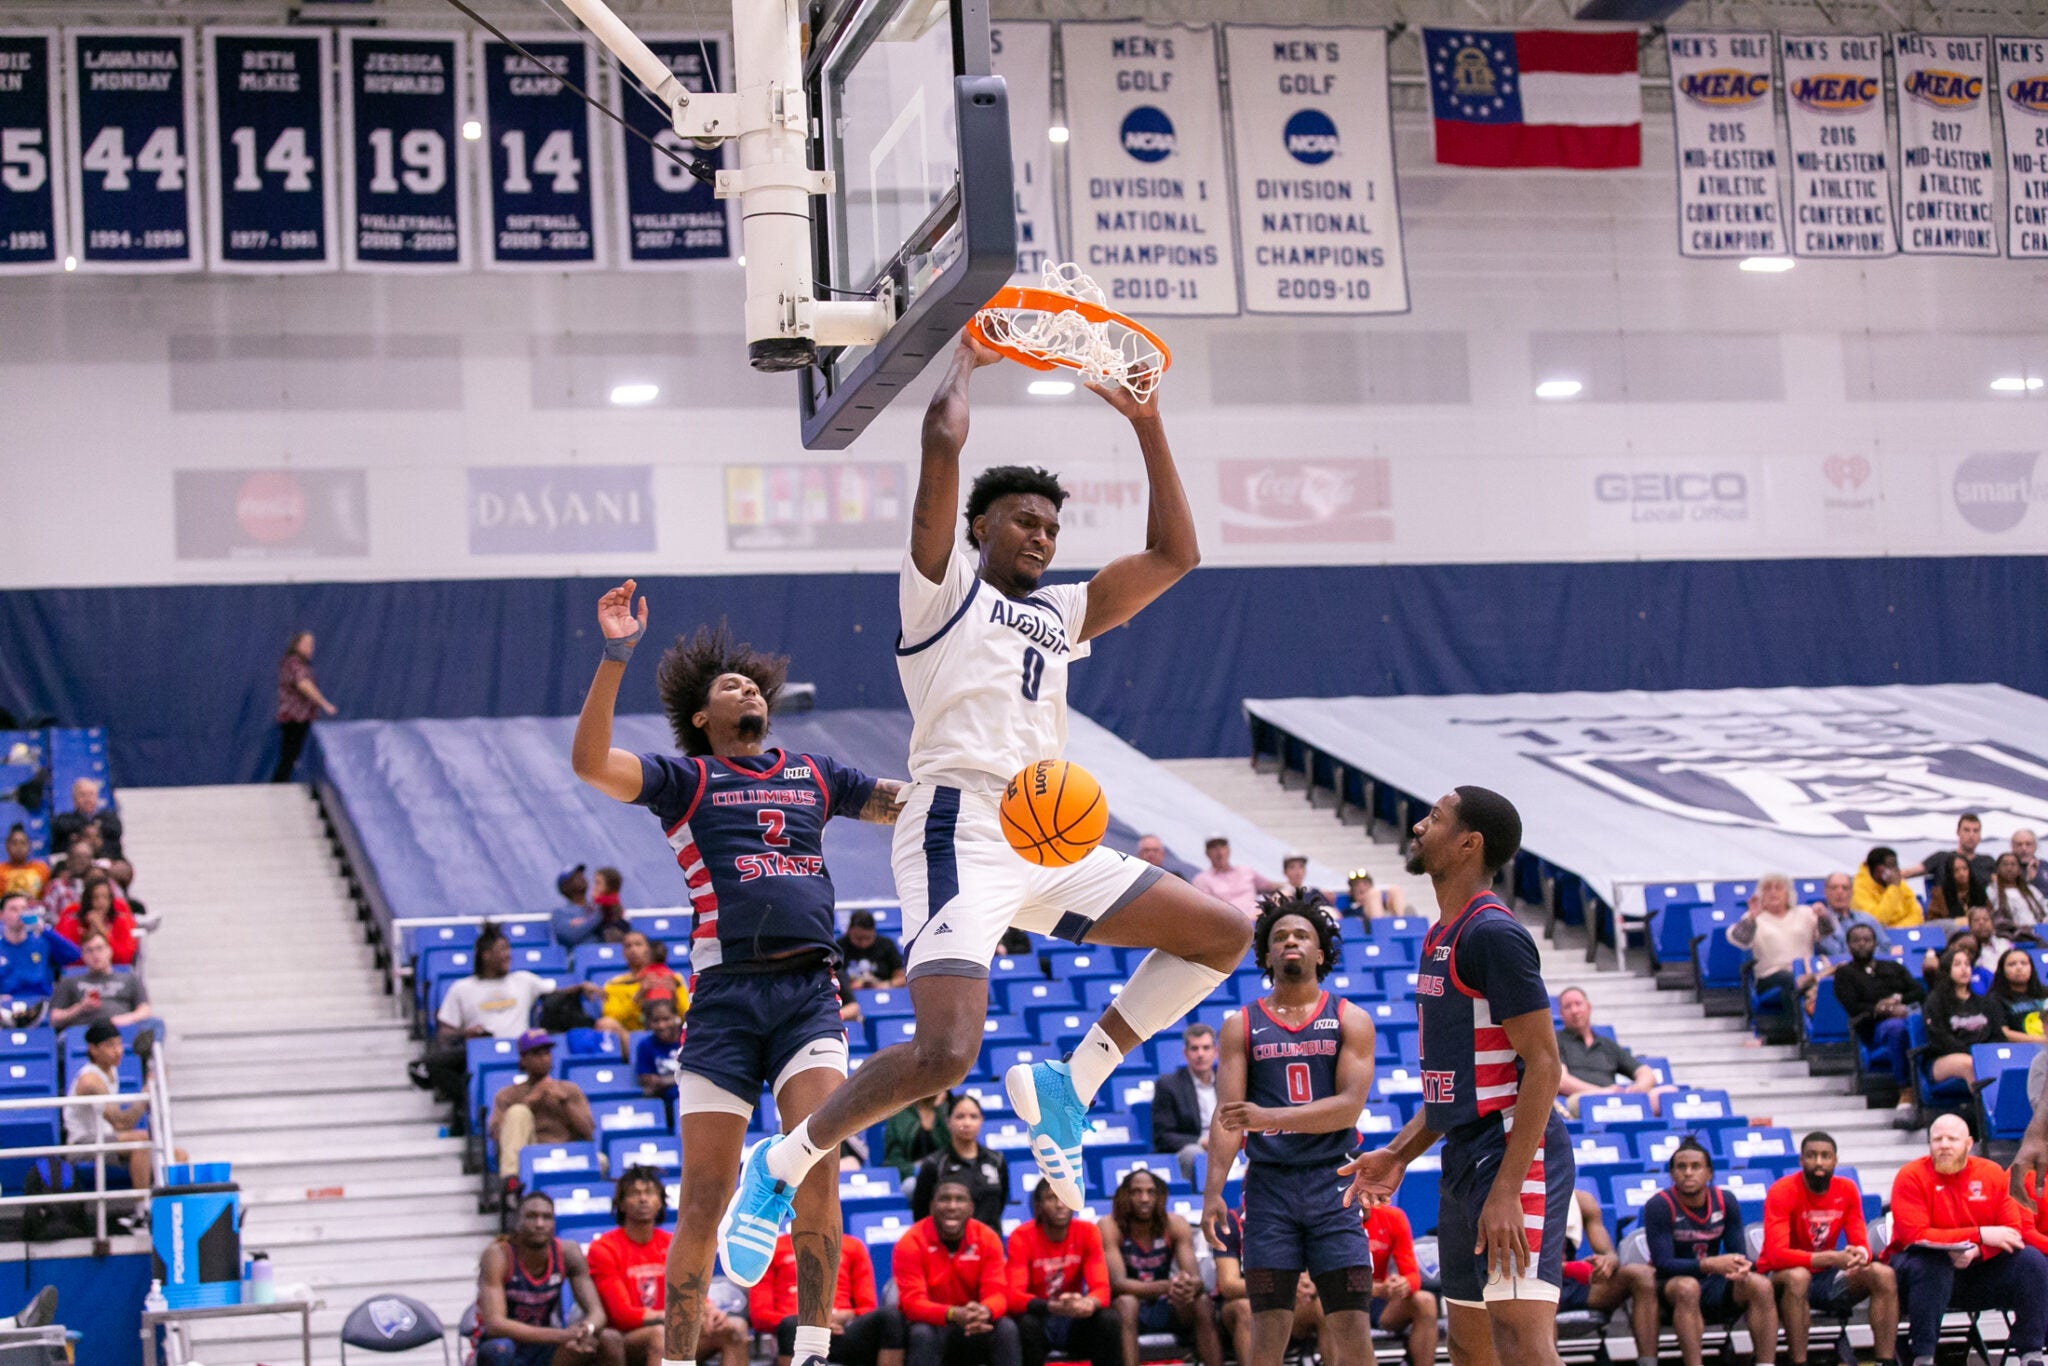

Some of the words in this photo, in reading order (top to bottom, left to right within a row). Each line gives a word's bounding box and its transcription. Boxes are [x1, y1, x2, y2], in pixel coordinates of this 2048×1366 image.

[1112, 36, 1175, 59] MEN'S
[1273, 41, 1340, 63] MEN'S
[1672, 38, 1717, 57] MEN'S
[1730, 38, 1767, 58] GOLF
[1784, 40, 1829, 61] MEN'S
[1841, 41, 1877, 61] GOLF
[1947, 42, 1982, 62] GOLF
[2000, 43, 2044, 62] MEN'S
[242, 52, 295, 70] BETH
[90, 72, 172, 91] MONDAY
[1116, 70, 1173, 92] GOLF
[1279, 75, 1337, 95] GOLF
[1686, 73, 1770, 98] MEAC
[1799, 78, 1878, 101] MEAC
[1913, 71, 1983, 99] MEAC
[1125, 132, 1176, 151] NCAA
[1708, 123, 1746, 143] 2015
[1820, 126, 1856, 146] 2016
[1932, 121, 1962, 143] 2017
[1288, 136, 1339, 154] NCAA
[84, 126, 185, 191] 44
[231, 127, 314, 191] 14
[368, 128, 447, 194] 19
[501, 129, 582, 194] 14
[1684, 149, 1776, 168] MID-EASTERN
[1797, 151, 1886, 172] MID-EASTERN
[1906, 147, 1992, 169] MID-EASTERN
[1089, 178, 1184, 199] DIVISION
[1256, 179, 1352, 201] DIVISION
[1698, 175, 1767, 195] ATHLETIC
[1810, 178, 1877, 199] ATHLETIC
[1920, 174, 1983, 196] ATHLETIC
[360, 213, 456, 231] VOLLEYBALL
[506, 213, 581, 231] SOFTBALL
[632, 211, 725, 230] VOLLEYBALL
[1096, 211, 1206, 233] NATIONAL
[1686, 202, 1776, 223] CONFERENC
[1801, 205, 1886, 226] CONFERENC
[1906, 202, 1992, 223] CONFERENC
[1262, 212, 1372, 235] NATIONAL
[1089, 244, 1218, 266] CHAMPIONS
[1256, 246, 1384, 268] CHAMPIONS
[1112, 278, 1198, 299] 2010-11
[1277, 278, 1370, 300] 2009-10
[1595, 473, 1747, 502] GEICO
[478, 482, 641, 531] DASANI
[1021, 646, 1045, 701] 0
[712, 789, 816, 807] COLUMBUS
[757, 809, 790, 847] 2
[735, 851, 824, 883] STATE
[1253, 1040, 1337, 1061] COLUMBUS
[1285, 1062, 1313, 1104] 0
